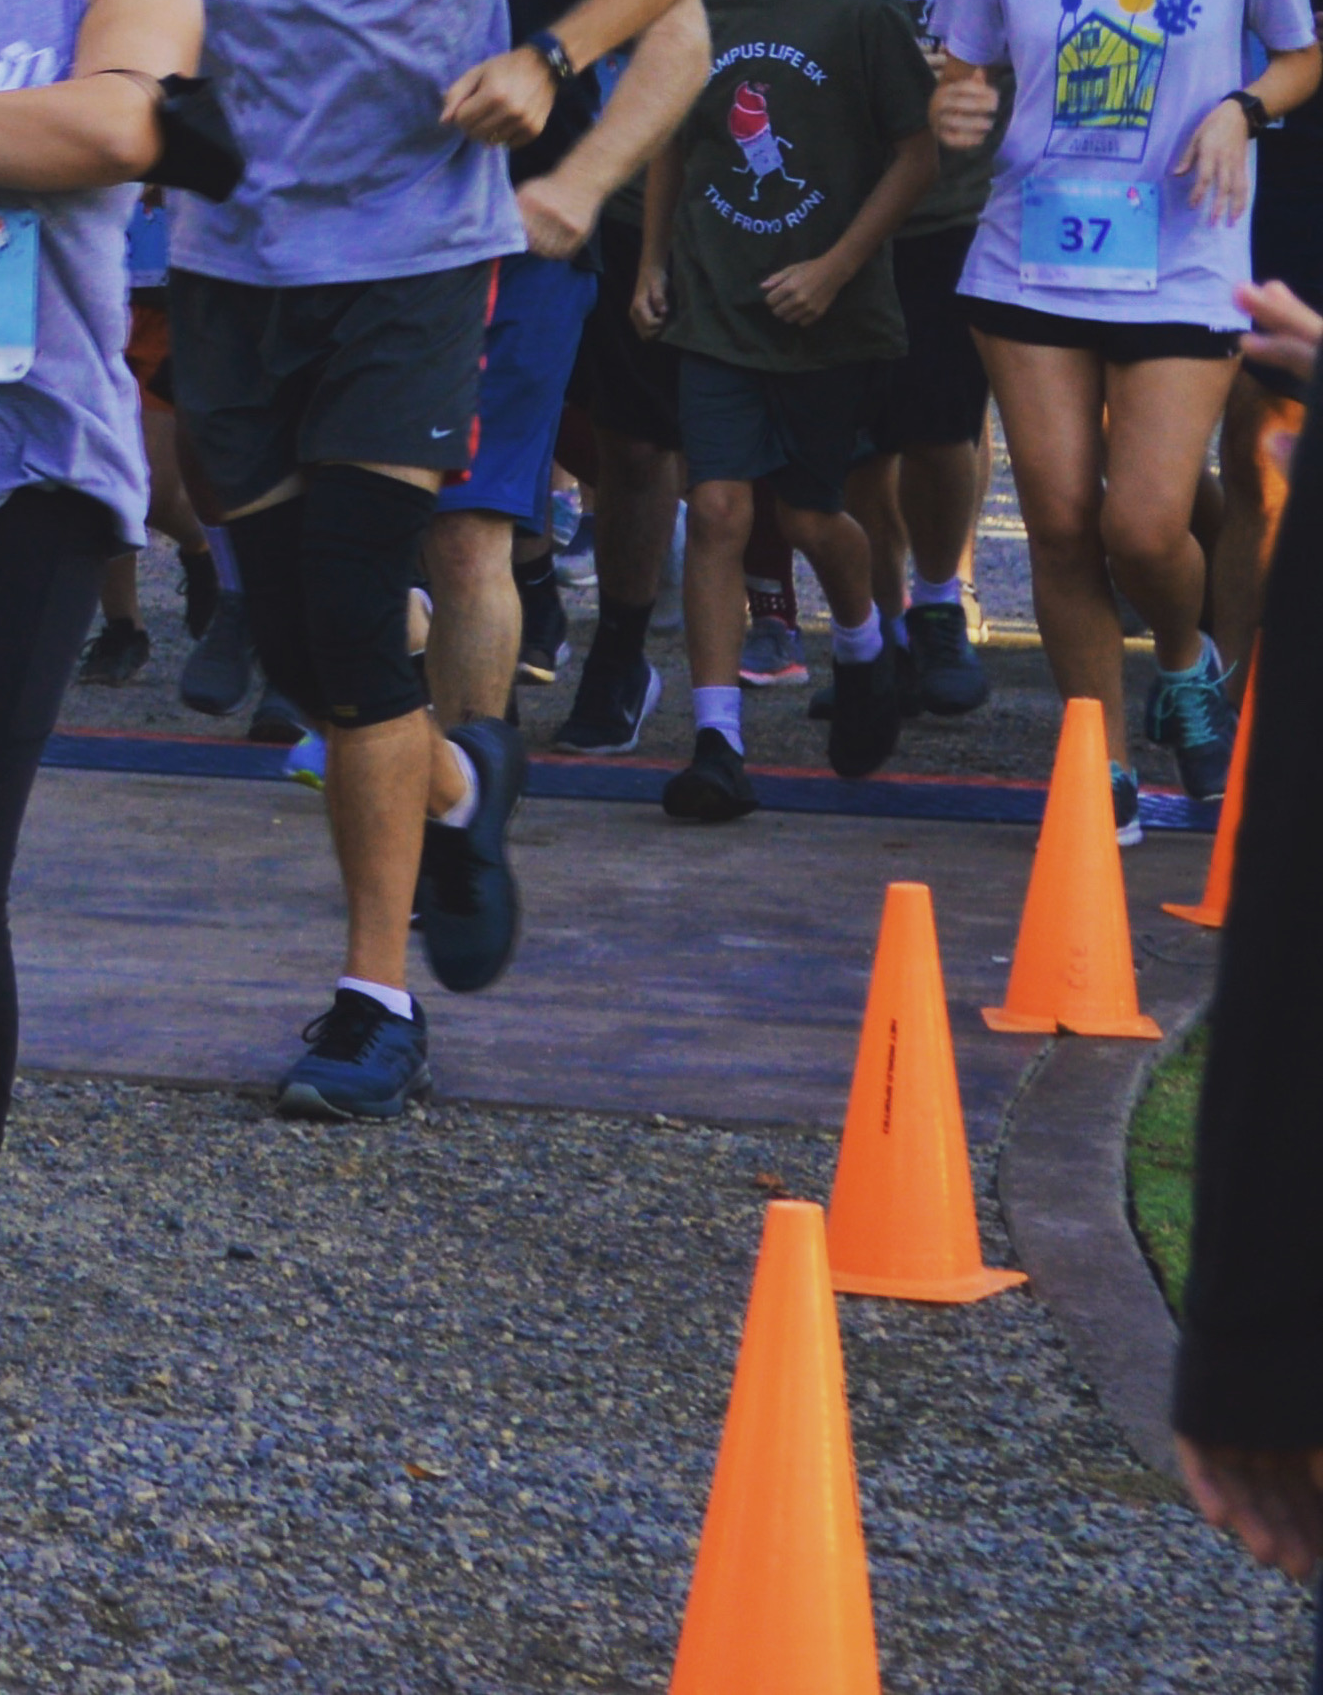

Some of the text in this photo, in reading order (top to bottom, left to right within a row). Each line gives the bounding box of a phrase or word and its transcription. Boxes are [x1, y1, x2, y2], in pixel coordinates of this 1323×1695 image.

[706, 42, 828, 86] AMPUS LIFE 5K
[704, 184, 733, 218] THE
[784, 189, 826, 228] RUN!
[1060, 216, 1112, 253] 37
